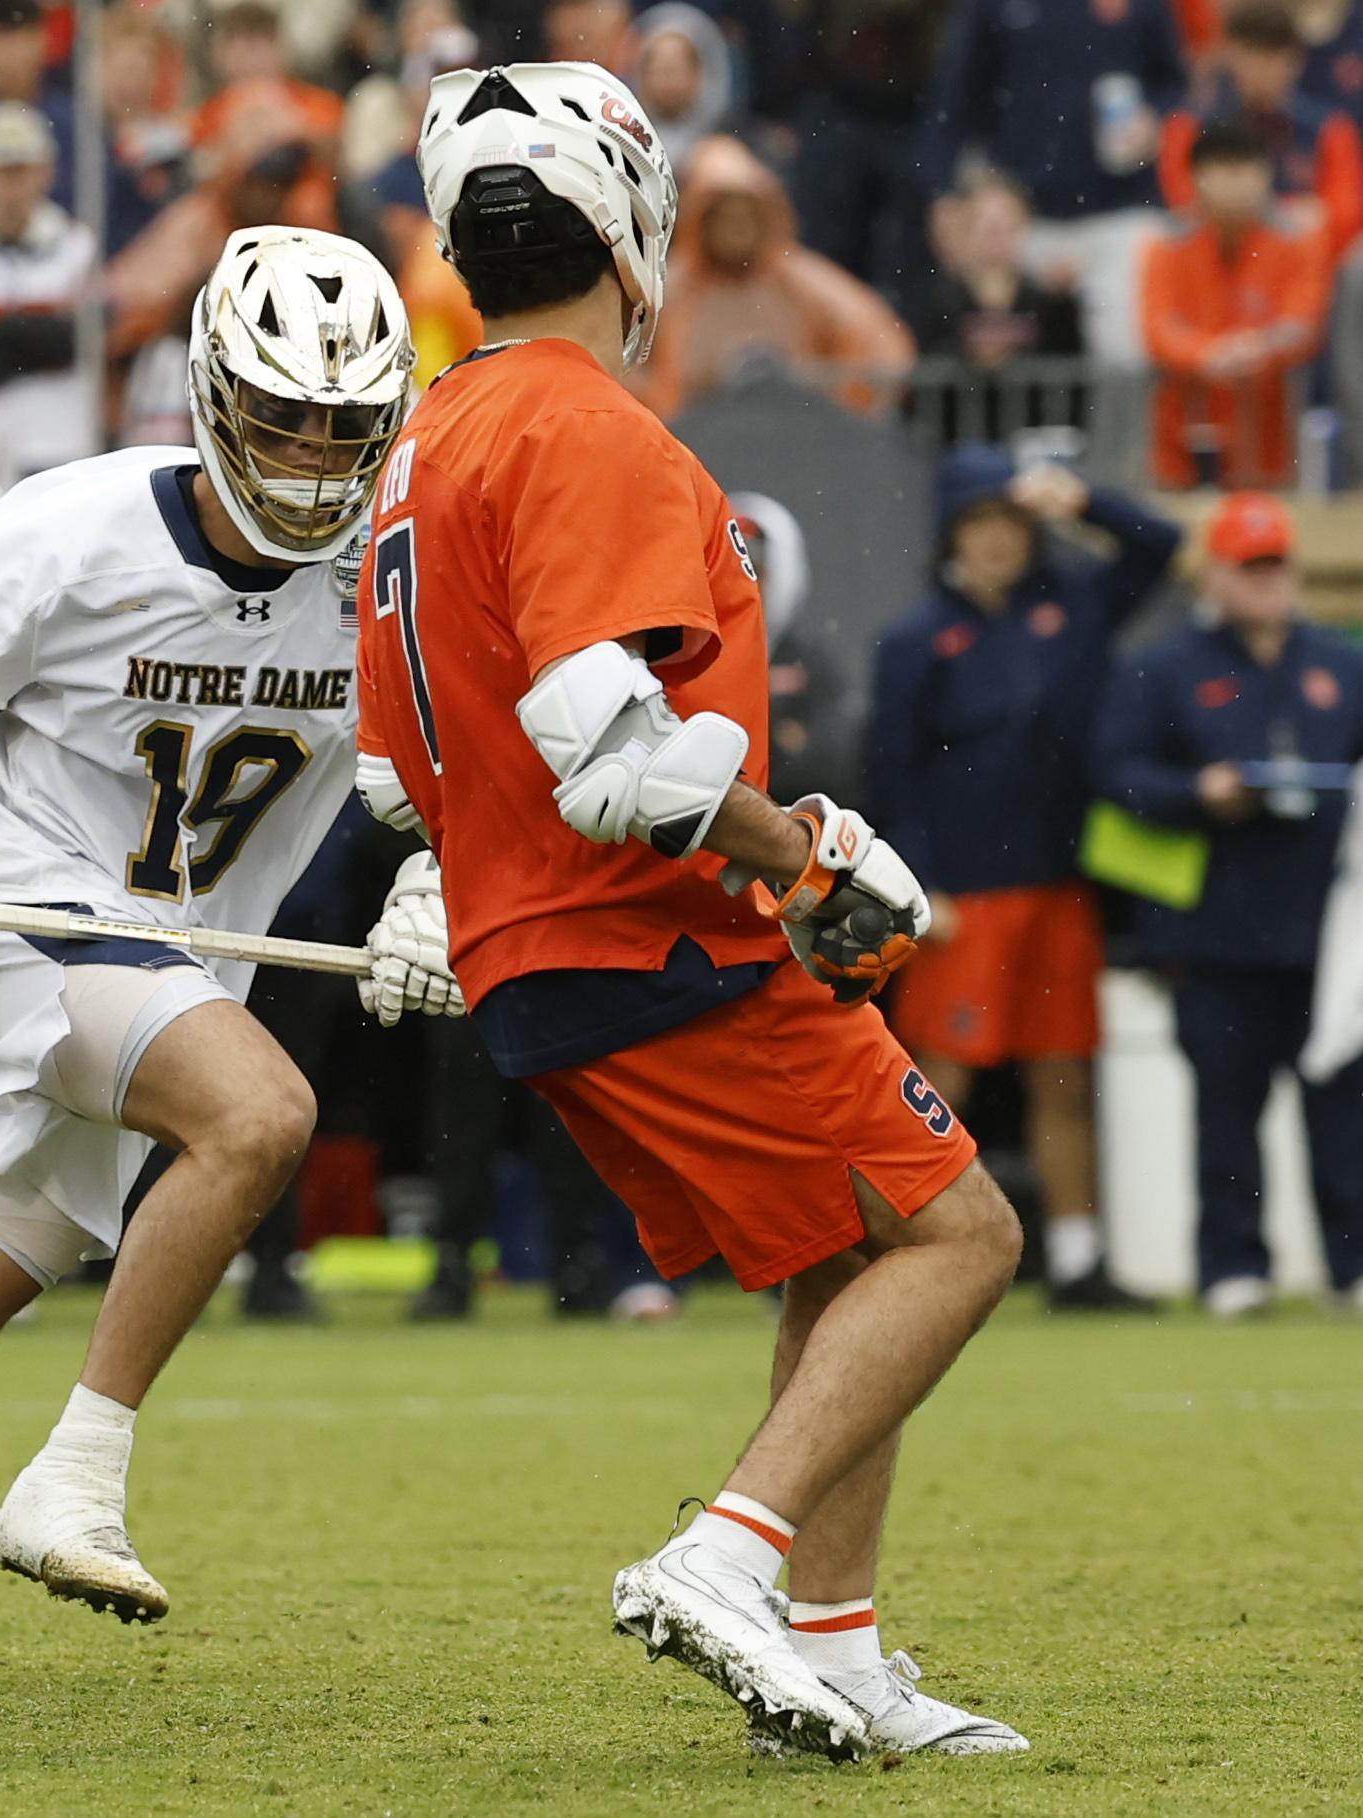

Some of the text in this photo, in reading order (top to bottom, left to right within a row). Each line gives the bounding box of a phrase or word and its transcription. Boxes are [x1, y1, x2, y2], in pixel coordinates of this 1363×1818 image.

[123, 656, 353, 709] NOTRE DAME
[374, 516, 443, 776] 7
[125, 719, 314, 906] 19
[900, 1071, 954, 1136] S
